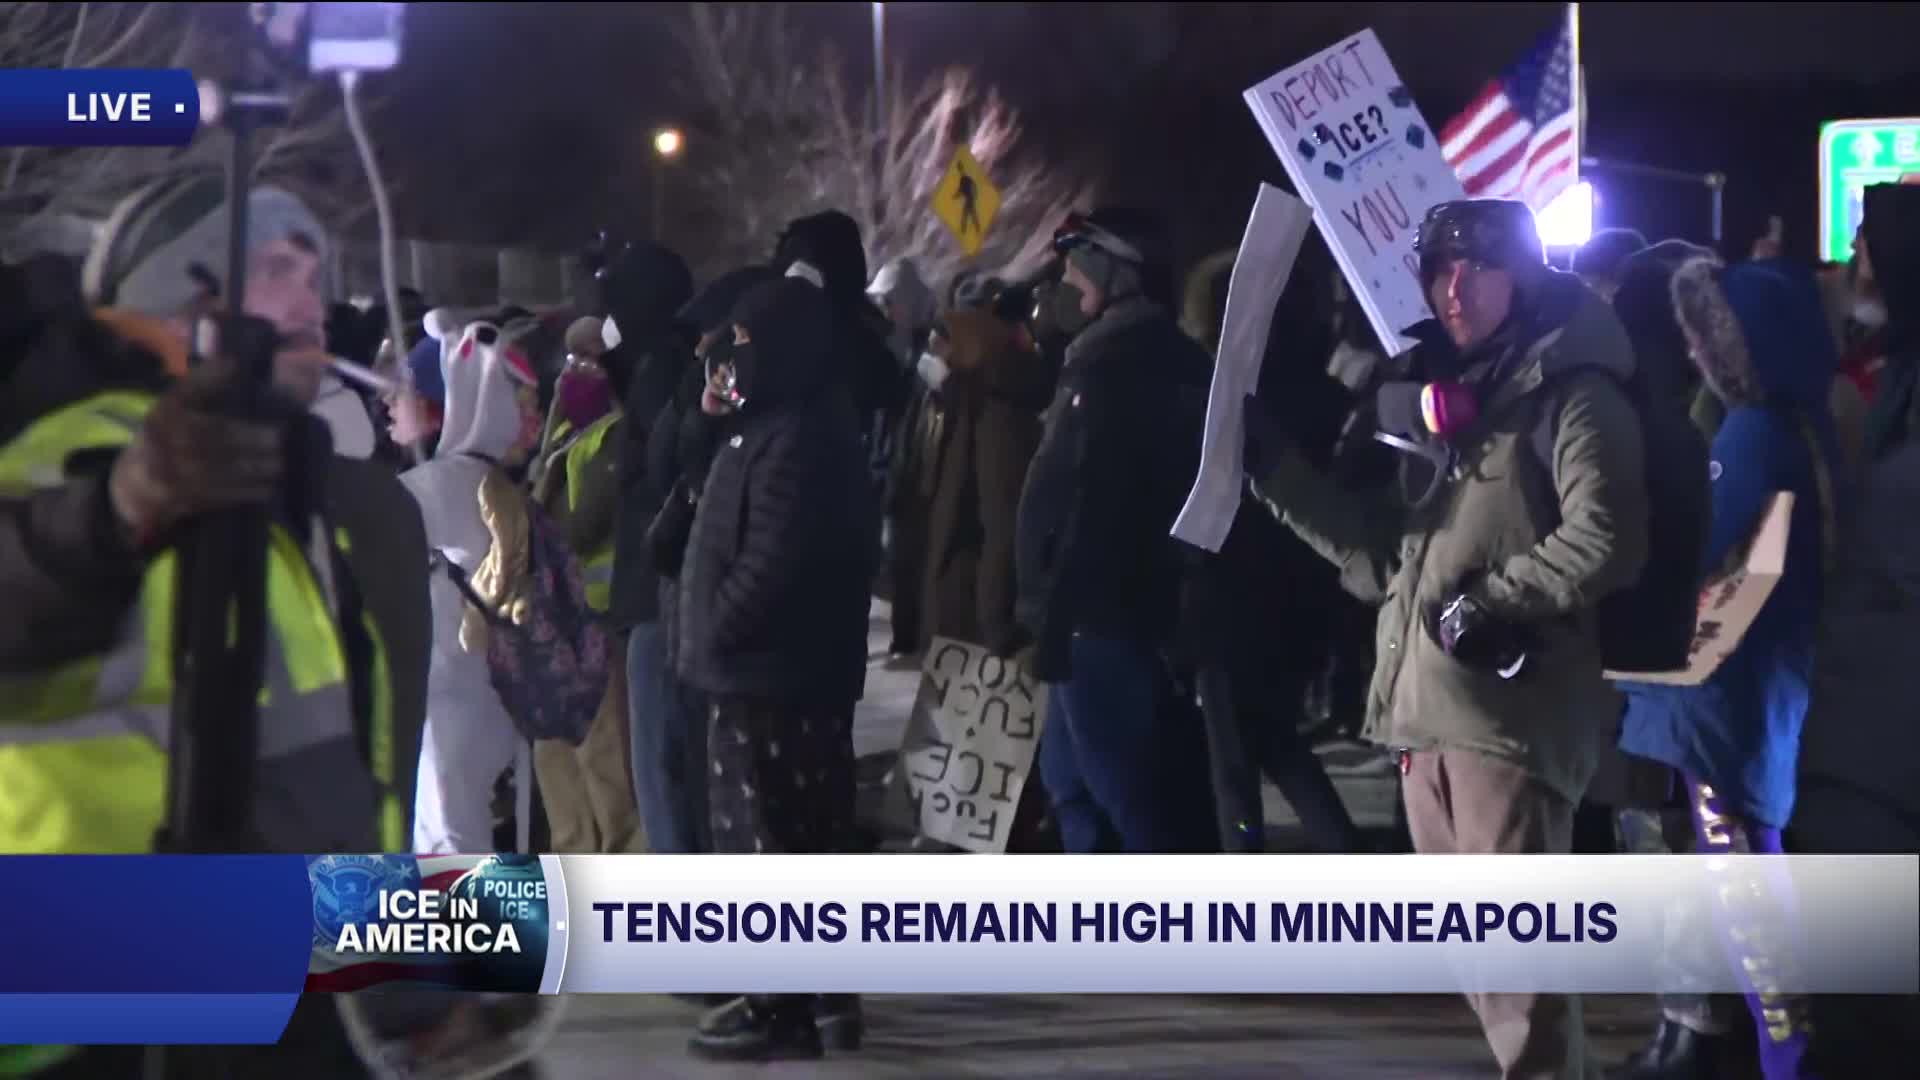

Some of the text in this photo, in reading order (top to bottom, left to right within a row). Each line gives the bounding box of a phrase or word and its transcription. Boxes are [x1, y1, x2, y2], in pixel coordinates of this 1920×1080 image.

[1271, 40, 1374, 131] DEPORT
[1325, 104, 1389, 159] ICE?
[1341, 181, 1411, 256] YOU
[934, 643, 1034, 705] YOU
[911, 742, 1017, 803] ICE
